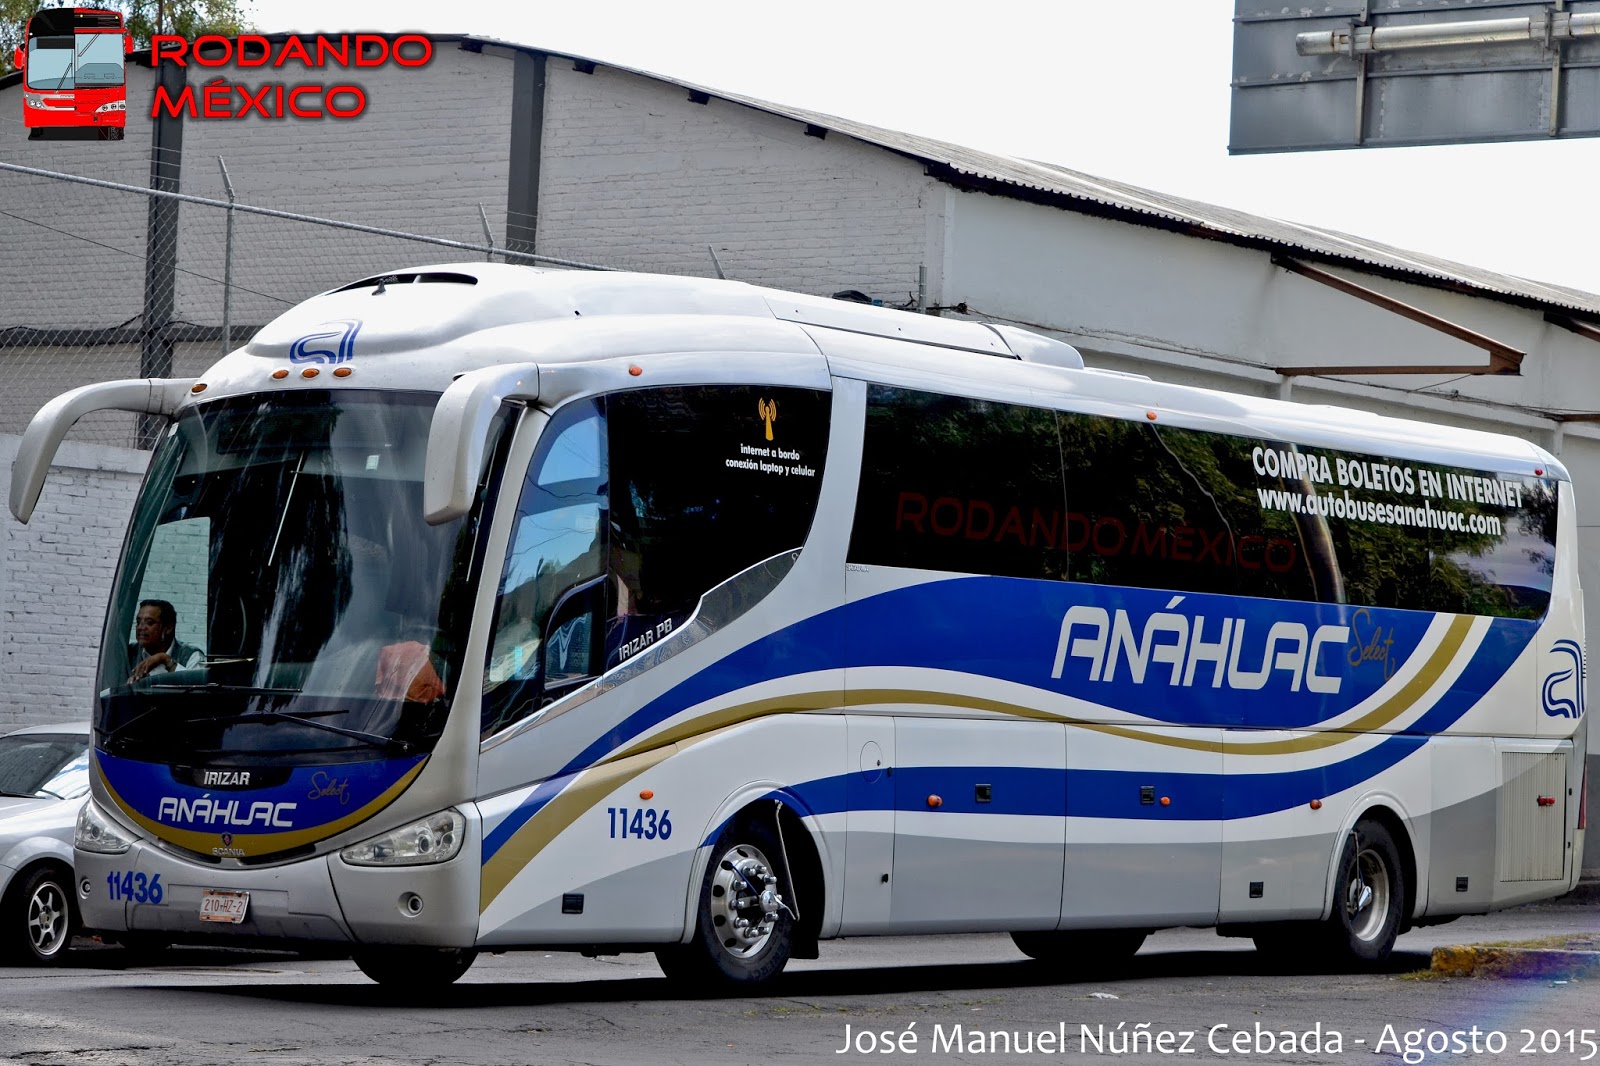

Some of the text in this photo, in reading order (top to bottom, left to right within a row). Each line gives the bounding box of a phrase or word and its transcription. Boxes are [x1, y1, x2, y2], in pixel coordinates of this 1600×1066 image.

[725, 459, 816, 477] conexión laptop y celular
[740, 443, 800, 460] internet a bordo
[1252, 446, 1523, 508] COMPRA BOLETOS EN INTERNET
[1257, 487, 1502, 536] www.autobusesanahuac.com
[618, 618, 673, 661] IRIZAR PB
[1347, 607, 1396, 682] Select
[203, 771, 251, 786] IRIZAR
[308, 771, 350, 805] Select
[607, 808, 672, 840] 11436
[212, 847, 246, 857] SCANIA
[107, 871, 163, 904] 11436
